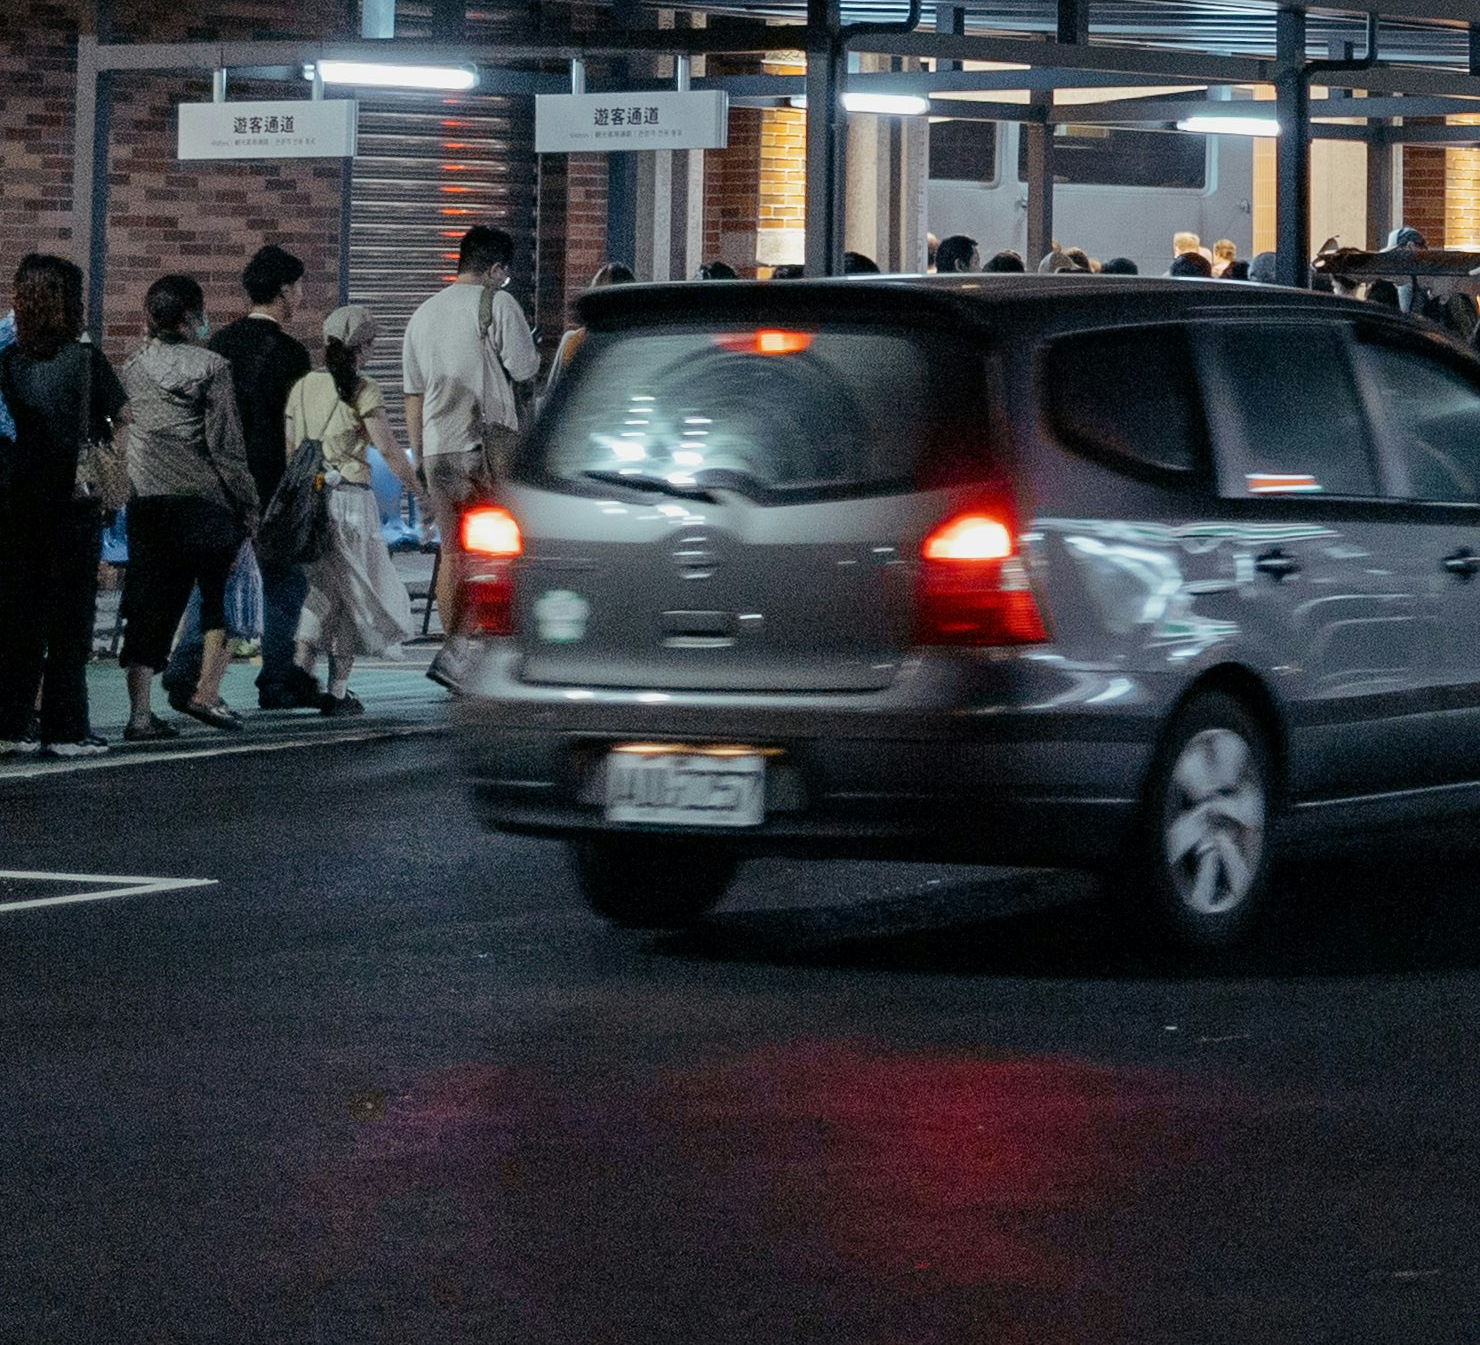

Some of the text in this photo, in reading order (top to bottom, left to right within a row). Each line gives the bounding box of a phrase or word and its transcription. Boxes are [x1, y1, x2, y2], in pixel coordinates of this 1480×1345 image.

[233, 114, 295, 134] 遊客通道
[593, 106, 660, 126] 遊客通道
